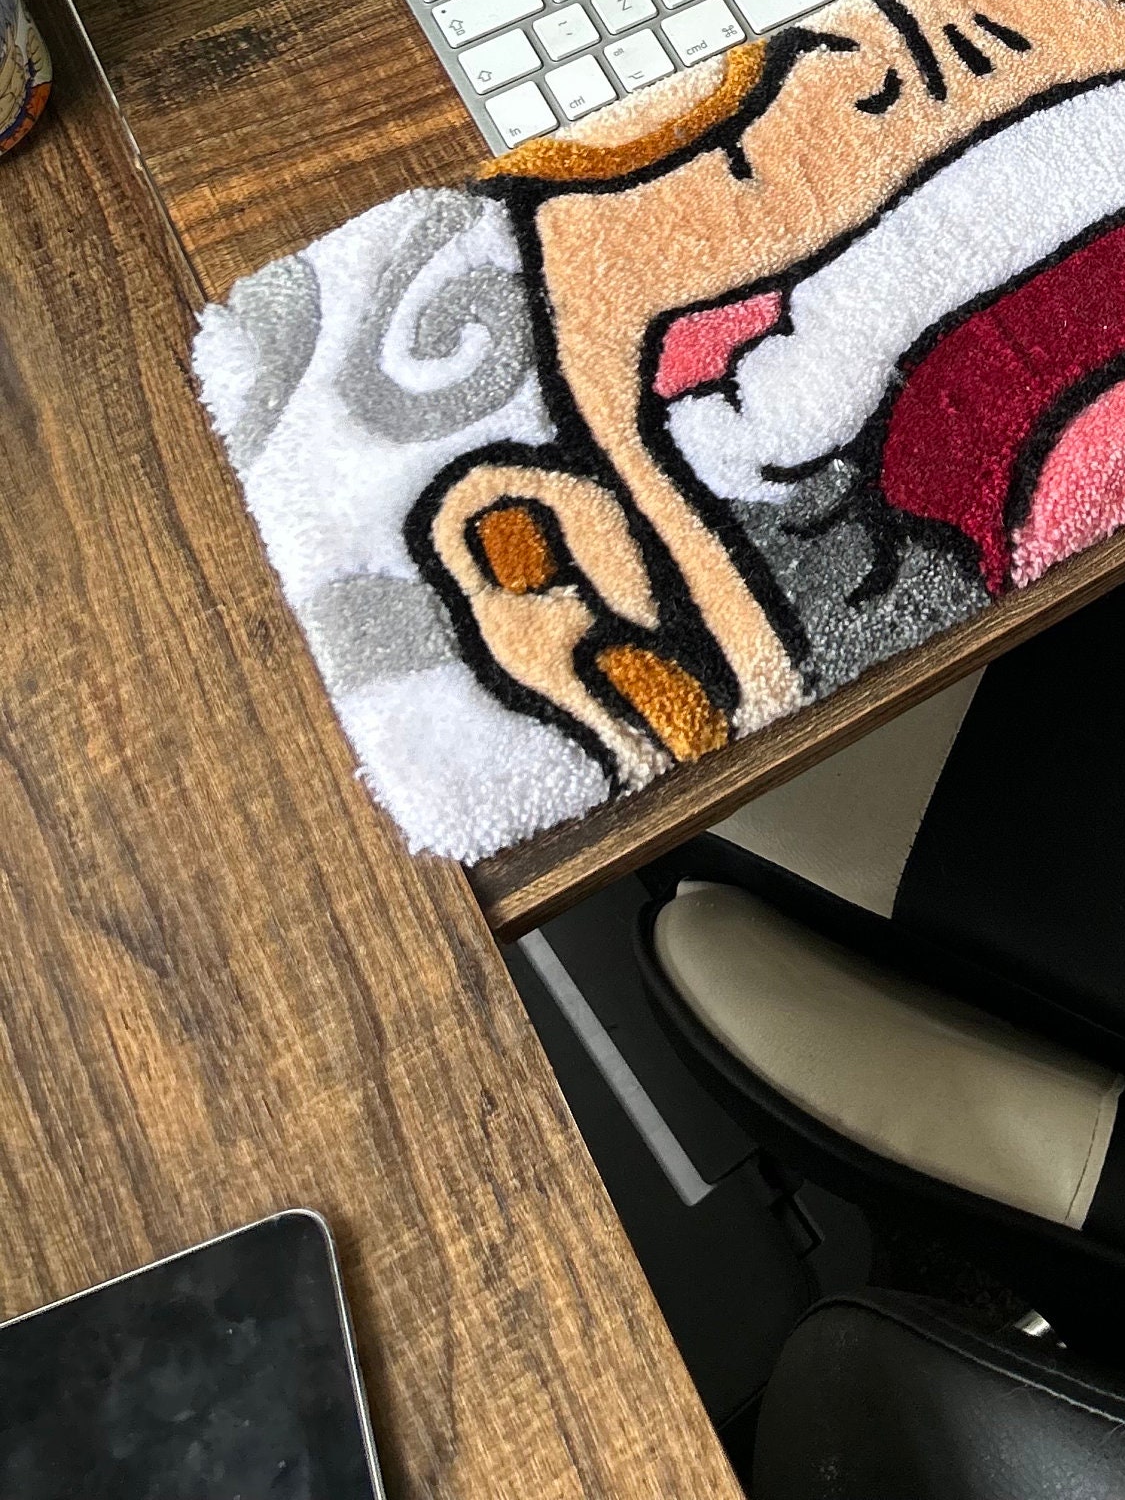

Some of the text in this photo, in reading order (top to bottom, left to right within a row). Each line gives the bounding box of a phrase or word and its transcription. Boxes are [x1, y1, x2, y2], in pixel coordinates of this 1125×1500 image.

[686, 40, 708, 57] cmd
[569, 95, 586, 110] ctrl
[509, 126, 522, 138] fn
